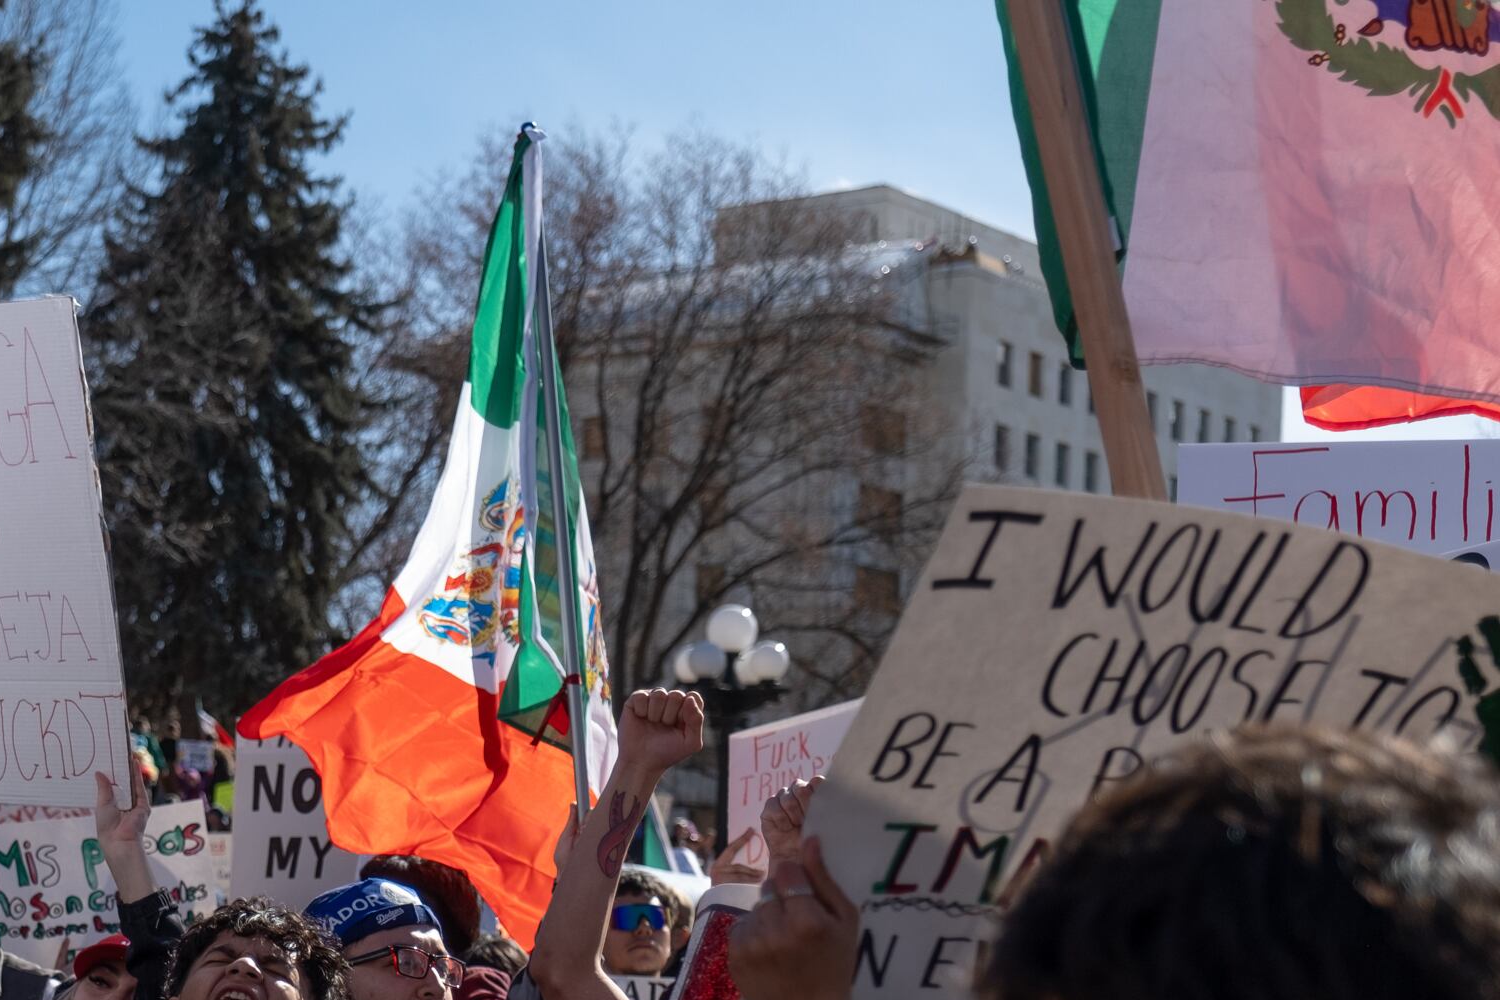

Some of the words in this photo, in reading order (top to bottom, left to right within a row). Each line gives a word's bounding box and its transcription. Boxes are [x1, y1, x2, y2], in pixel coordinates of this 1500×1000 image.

[931, 510, 1045, 590] I
[1050, 518, 1372, 639] WOULD
[1040, 632, 1331, 735] CHOOSE
[753, 731, 811, 772] FUCK
[869, 712, 976, 790] BE
[973, 733, 1041, 812] A
[265, 836, 334, 879] MY
